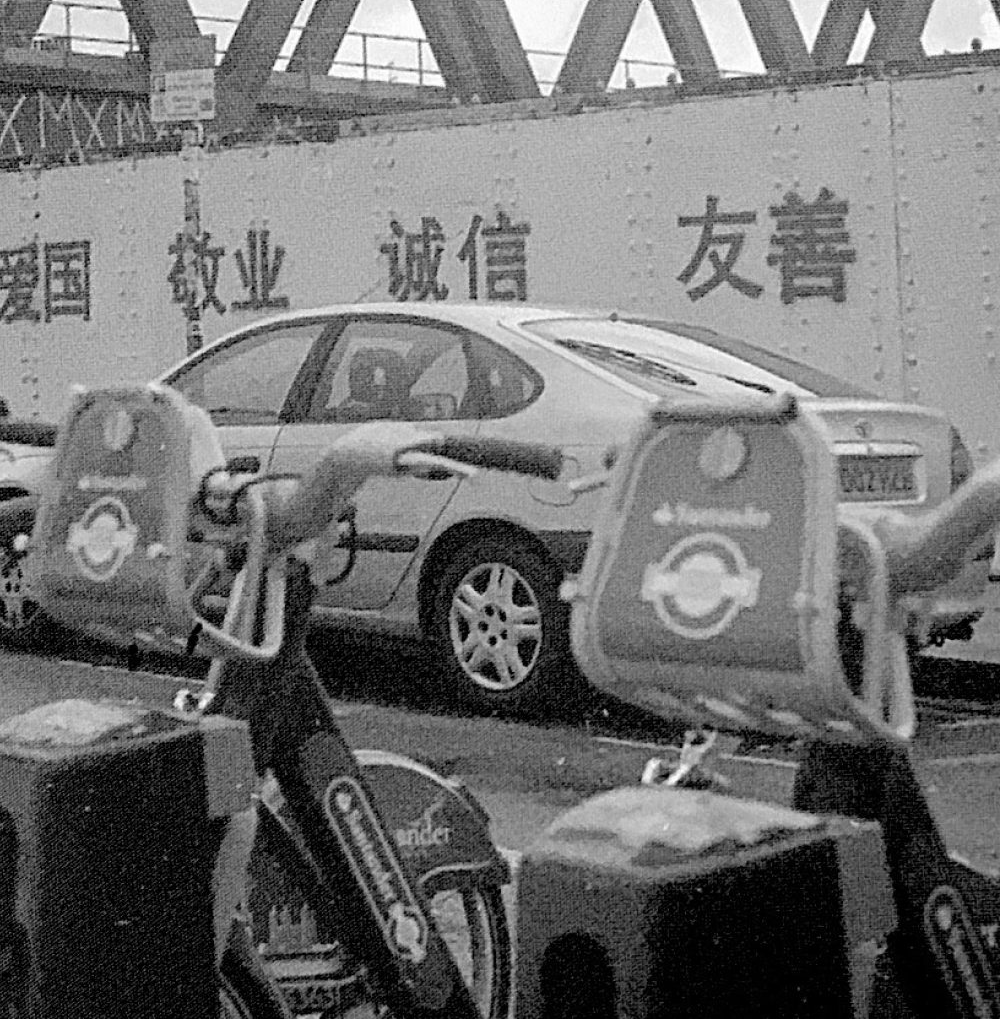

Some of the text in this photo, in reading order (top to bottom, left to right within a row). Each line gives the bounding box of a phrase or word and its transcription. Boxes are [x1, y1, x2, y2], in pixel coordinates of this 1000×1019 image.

[167, 229, 290, 317] 敬业
[380, 210, 531, 303] 诚信
[676, 185, 857, 306] 友善
